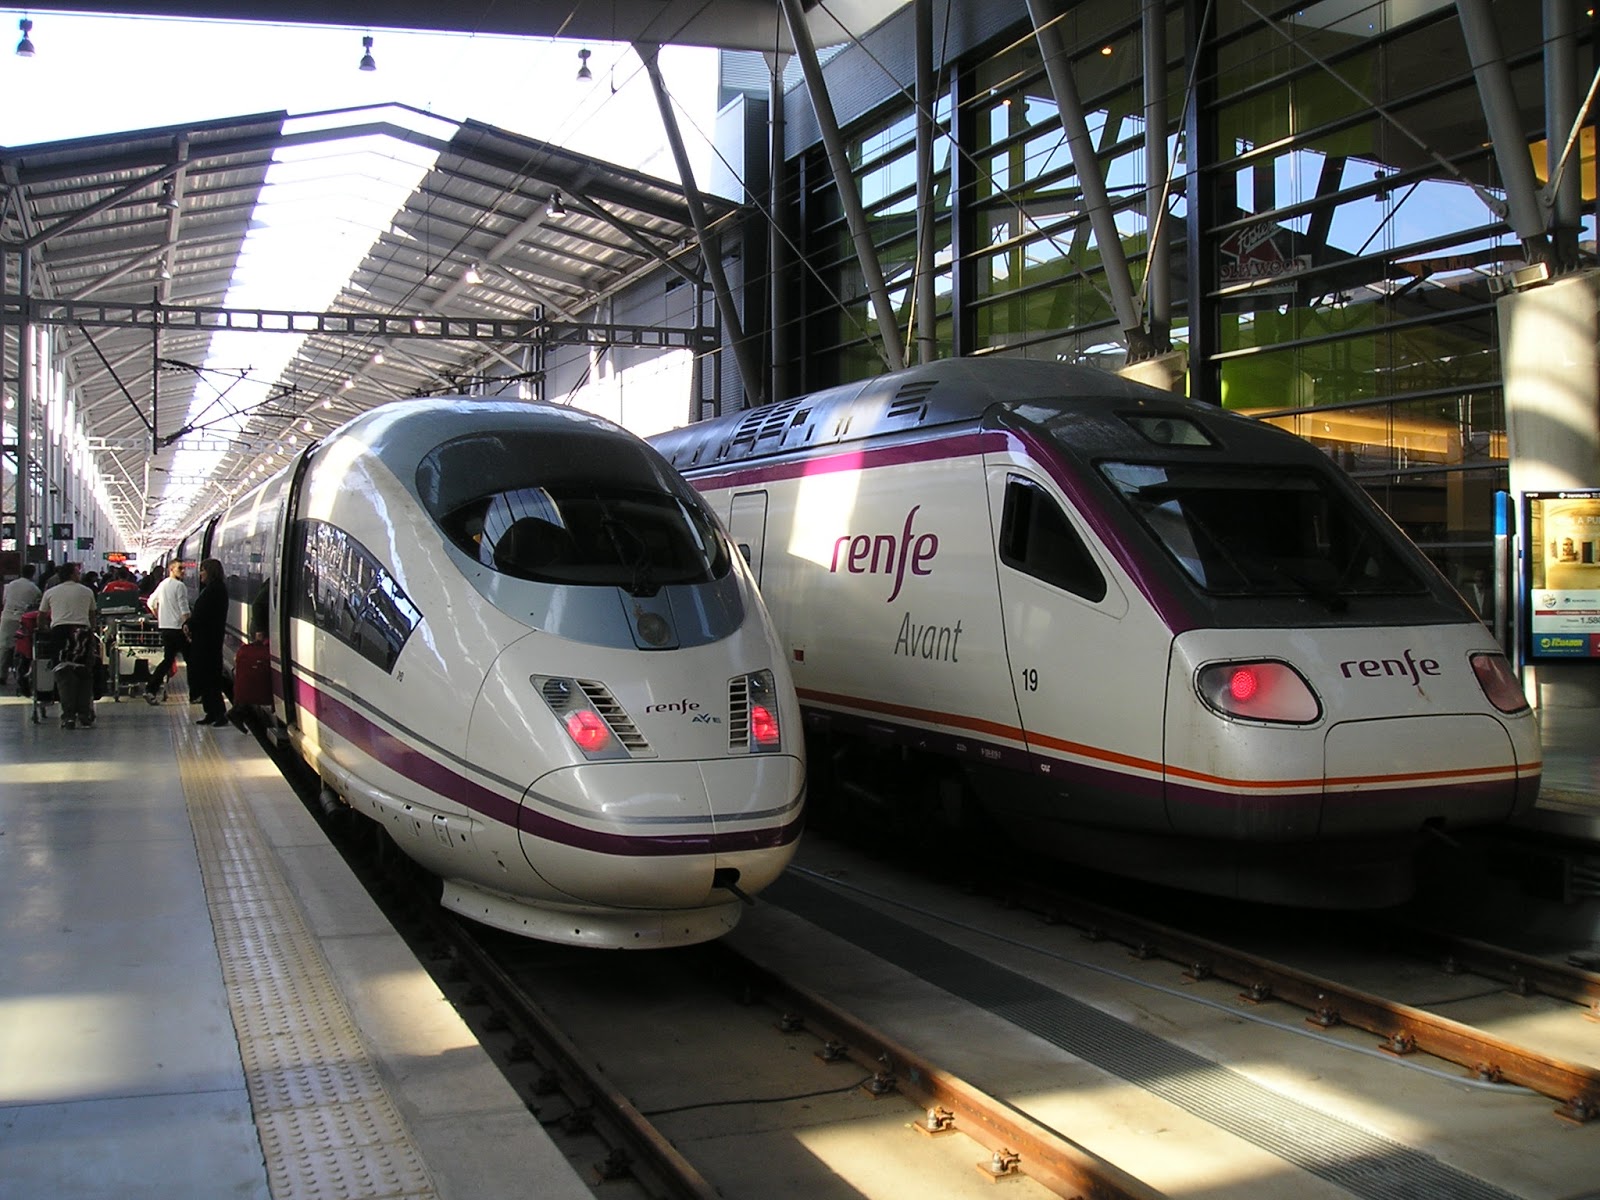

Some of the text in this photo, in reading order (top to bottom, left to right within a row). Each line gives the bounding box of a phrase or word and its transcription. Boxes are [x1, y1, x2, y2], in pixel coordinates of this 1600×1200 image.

[1220, 258, 1307, 278] OLLYWOOD
[830, 505, 939, 603] renfe
[894, 612, 962, 663] Avant
[1340, 648, 1442, 687] renfe
[1022, 669, 1038, 692] 19
[645, 698, 700, 715] renfe
[692, 713, 722, 724] AVE
